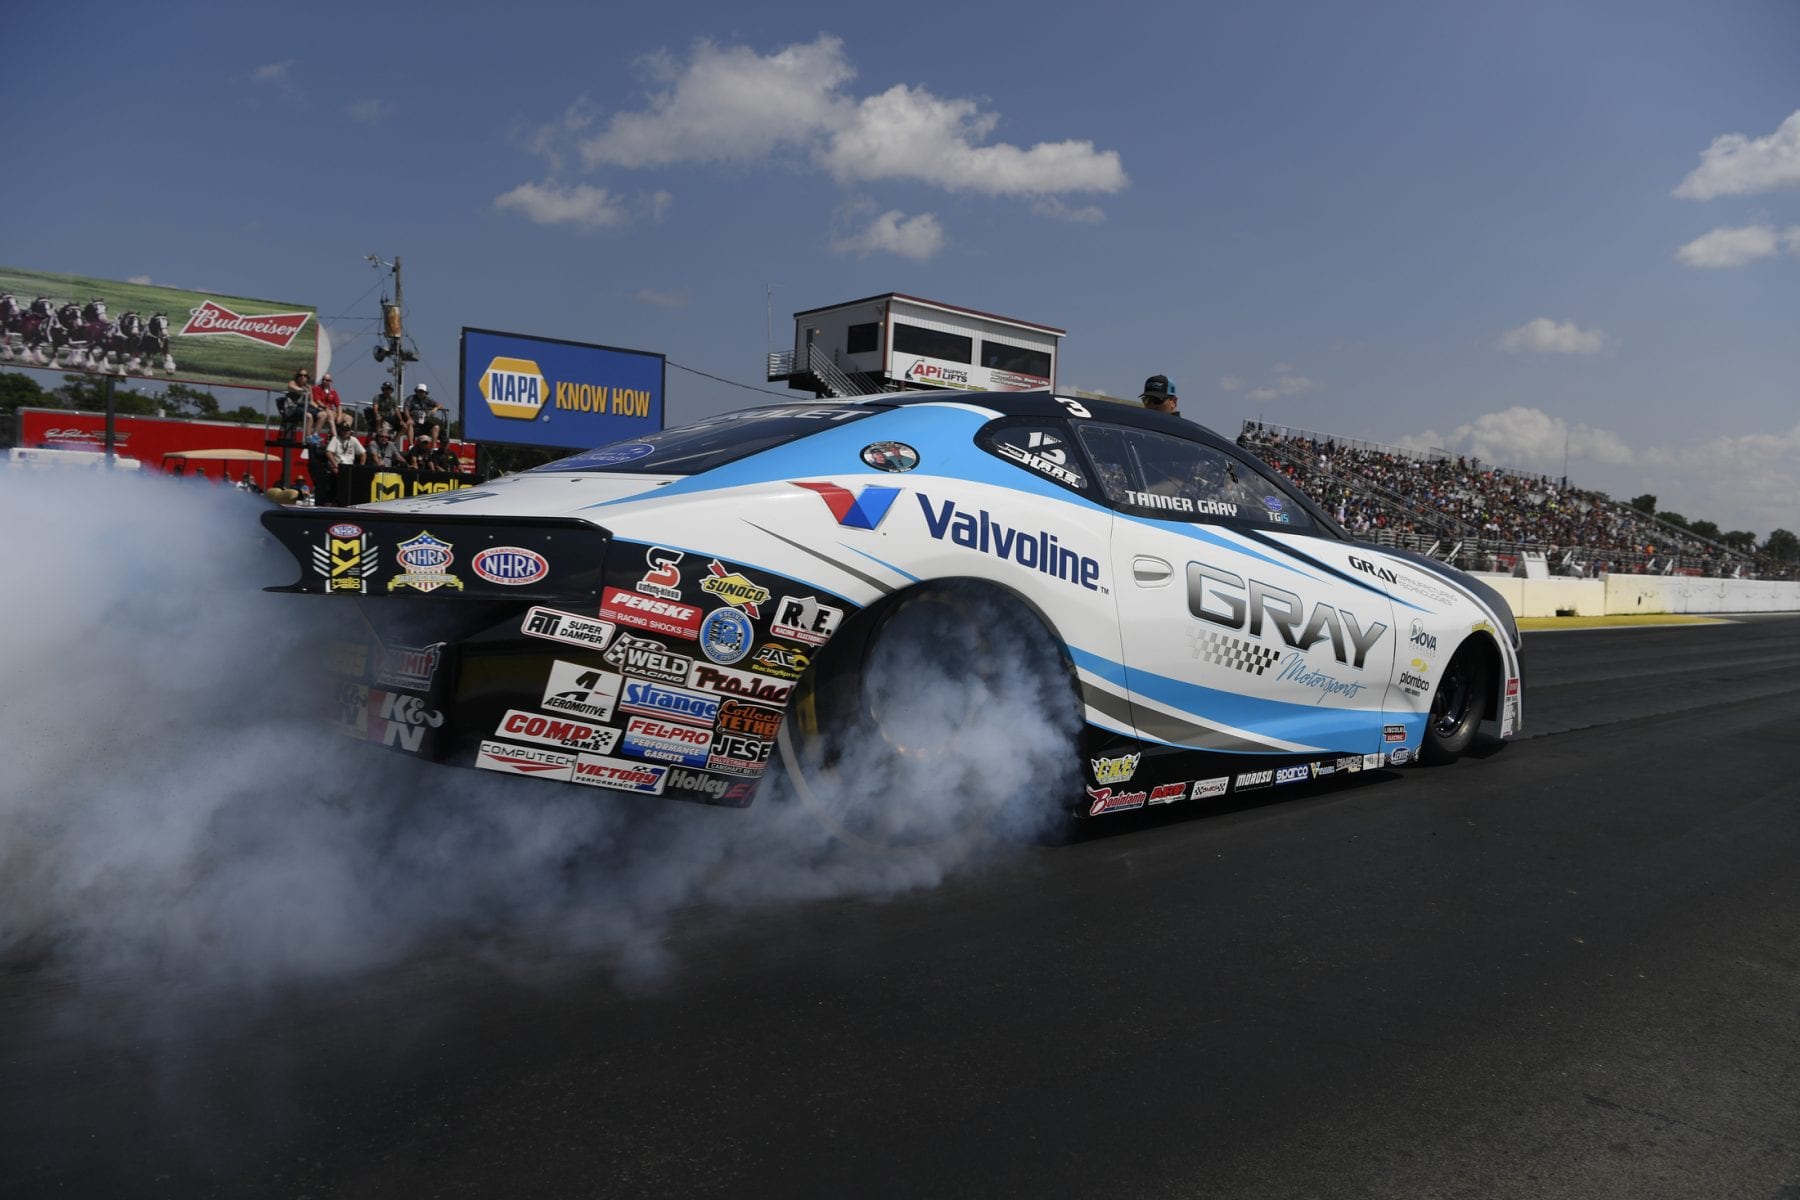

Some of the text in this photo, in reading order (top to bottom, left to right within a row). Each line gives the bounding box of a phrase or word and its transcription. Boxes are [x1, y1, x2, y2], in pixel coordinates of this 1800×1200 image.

[190, 306, 298, 337] Budweiser
[942, 372, 968, 383] LIFTS
[491, 372, 650, 418] NAPA KNOW HOW
[1054, 397, 1092, 418] 3
[413, 479, 473, 496] Mell
[1125, 489, 1238, 516] TANNER GRAY
[333, 526, 358, 535] NHRA
[915, 492, 1100, 591] Valvoline
[406, 549, 445, 566] NHRA
[485, 554, 537, 577] NHRA
[1348, 555, 1397, 585] GRAY
[706, 579, 765, 602] SUNOCO
[611, 592, 695, 621] PENSKE
[1185, 560, 1388, 671] GRAY
[568, 621, 603, 635] SUPER
[617, 613, 682, 635] RACING SHOCKS
[560, 628, 603, 644] DAMPER
[628, 648, 688, 675] WELD
[753, 646, 797, 668] PAC
[625, 666, 684, 683] RACING
[1277, 652, 1367, 704] Motorsports
[1399, 672, 1430, 692] plombco
[544, 696, 608, 718] AEROMOTIVE
[622, 682, 717, 718] Strange
[504, 713, 594, 743] COMP
[628, 720, 710, 745] FEL-PRO
[480, 743, 575, 767] COMPUTECH
[560, 738, 602, 751] CAMS
[632, 738, 700, 756] PERFORMANCE
[644, 749, 685, 763] GASKETS
[575, 762, 657, 784] VICTORY
[575, 776, 635, 790] PERFORMANCE
[1236, 770, 1272, 787] MOROSO
[1276, 766, 1308, 782] sparco
[668, 770, 729, 799] Holley
[1151, 784, 1186, 799] ARP
